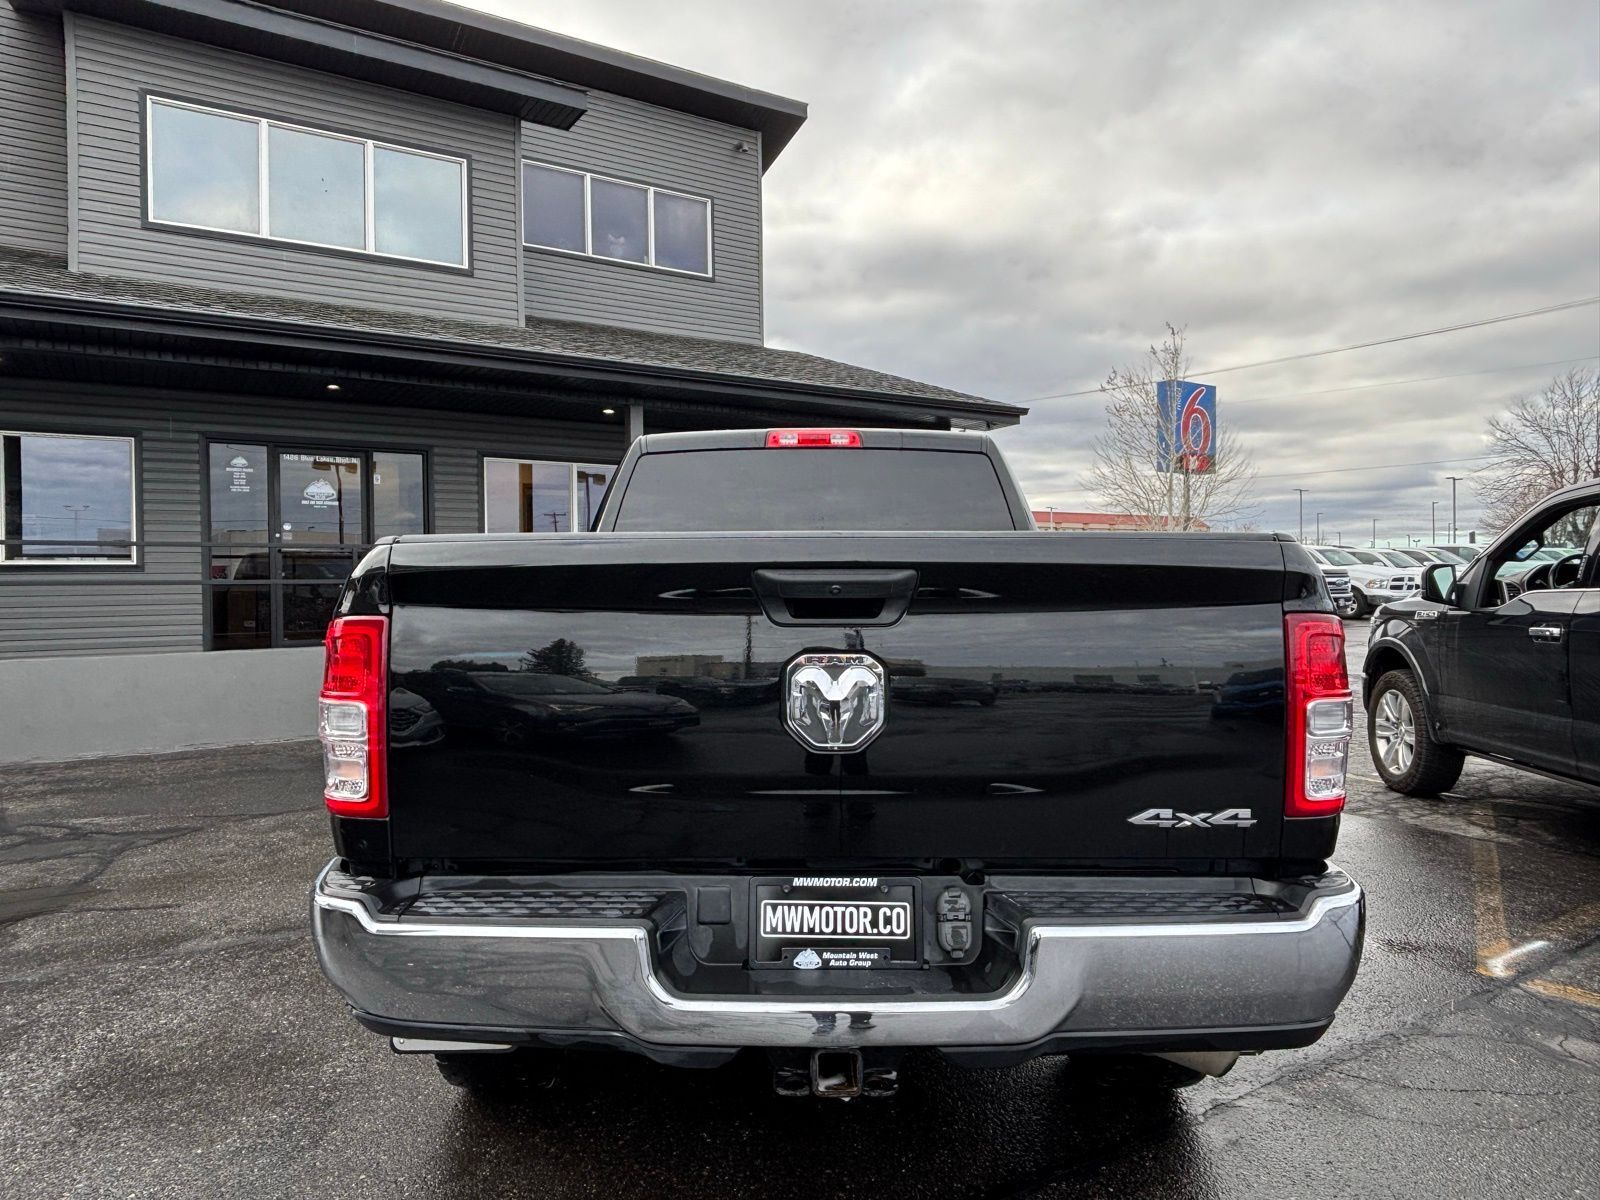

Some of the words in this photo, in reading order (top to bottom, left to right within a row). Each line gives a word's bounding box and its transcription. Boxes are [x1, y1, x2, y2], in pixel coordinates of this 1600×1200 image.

[1181, 387, 1212, 456] 6
[806, 655, 864, 665] RAM
[793, 877, 878, 887] MWMOTOR.COM
[765, 905, 905, 934] MWMOTOR.CO
[829, 959, 848, 967] Auto
[848, 959, 872, 968] Group
